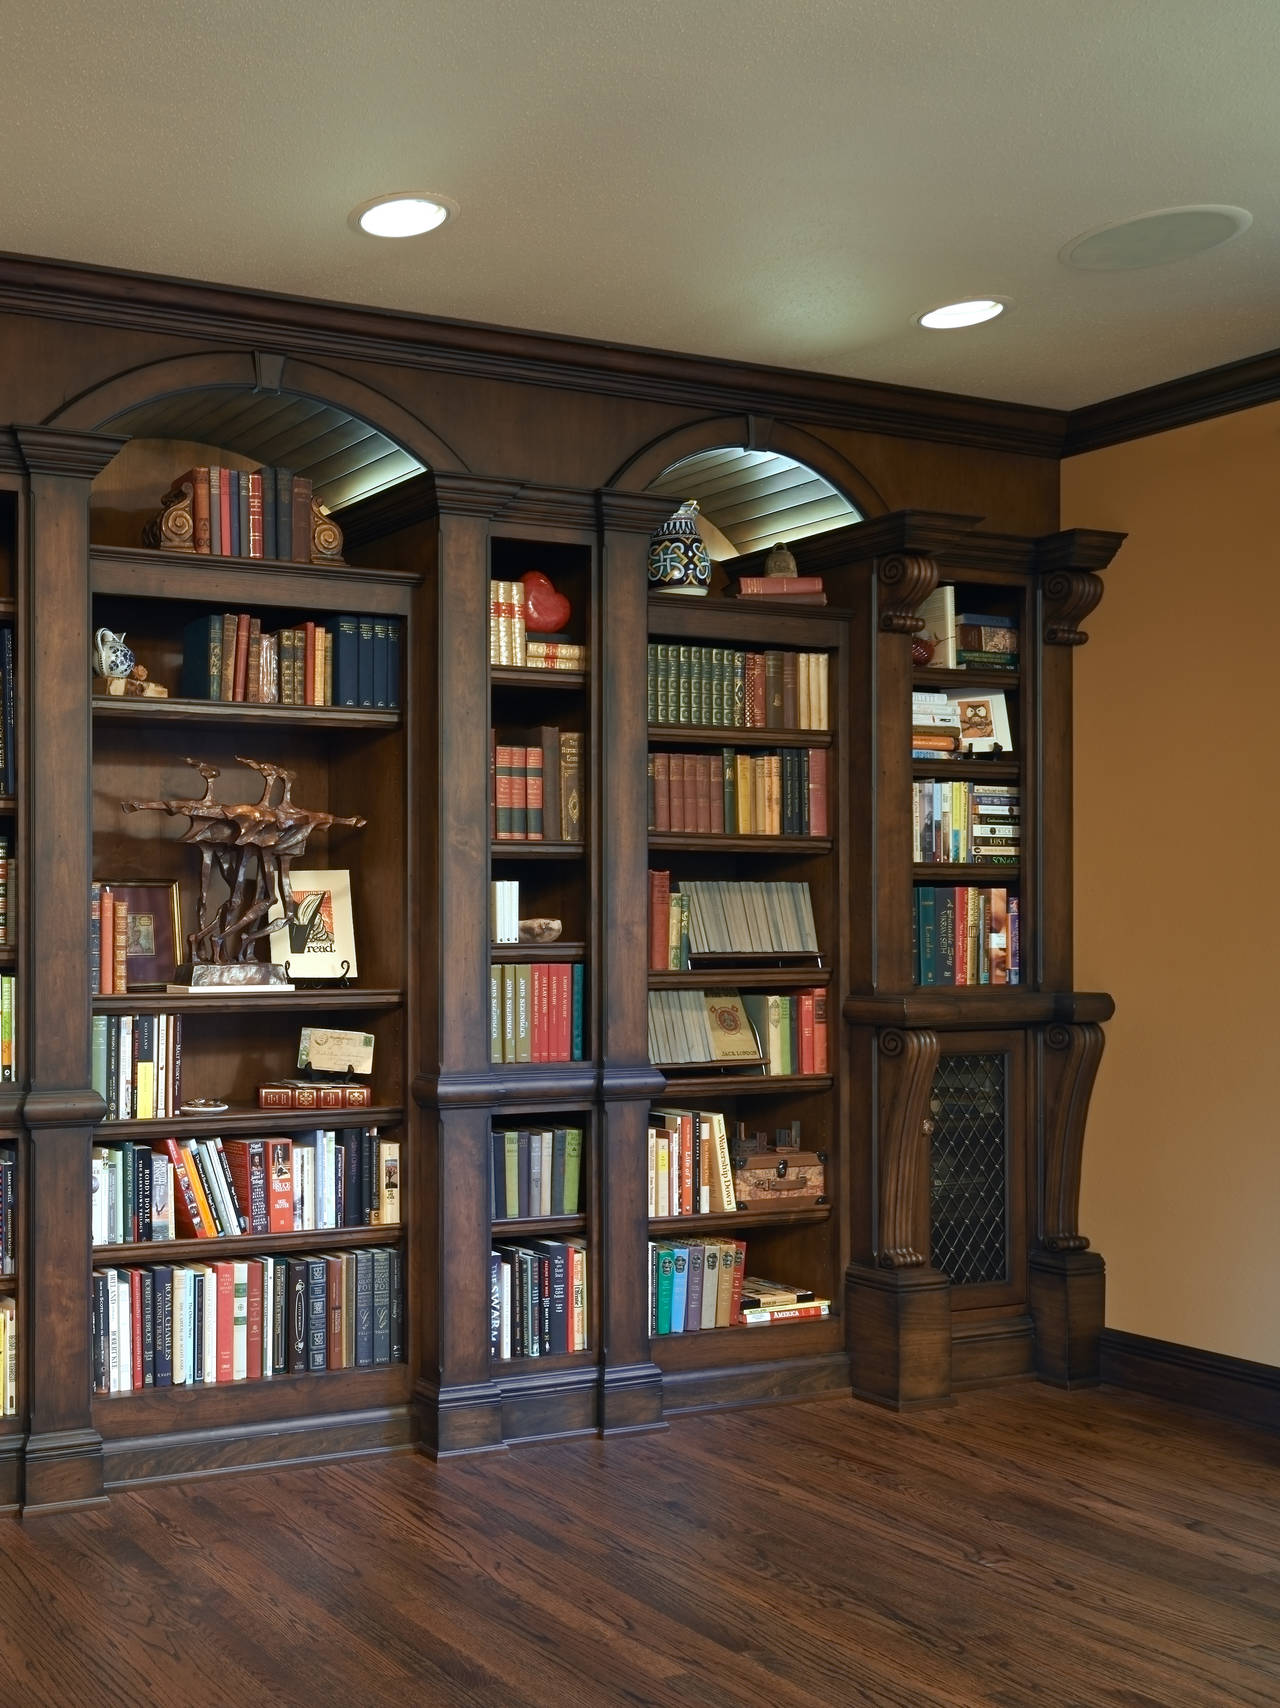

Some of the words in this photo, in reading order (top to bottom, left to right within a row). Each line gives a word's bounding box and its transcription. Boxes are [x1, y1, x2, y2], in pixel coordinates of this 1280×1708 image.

[307, 943, 336, 954] read.
[718, 1134, 729, 1178] Watership
[685, 1168, 691, 1176] of
[685, 1178, 691, 1187] Pi
[722, 1180, 733, 1206] Down
[109, 1273, 117, 1305] IRELAND
[144, 1279, 152, 1304] ROBERT
[491, 1283, 500, 1342] SWARM
[773, 1310, 799, 1319] AMERICA
